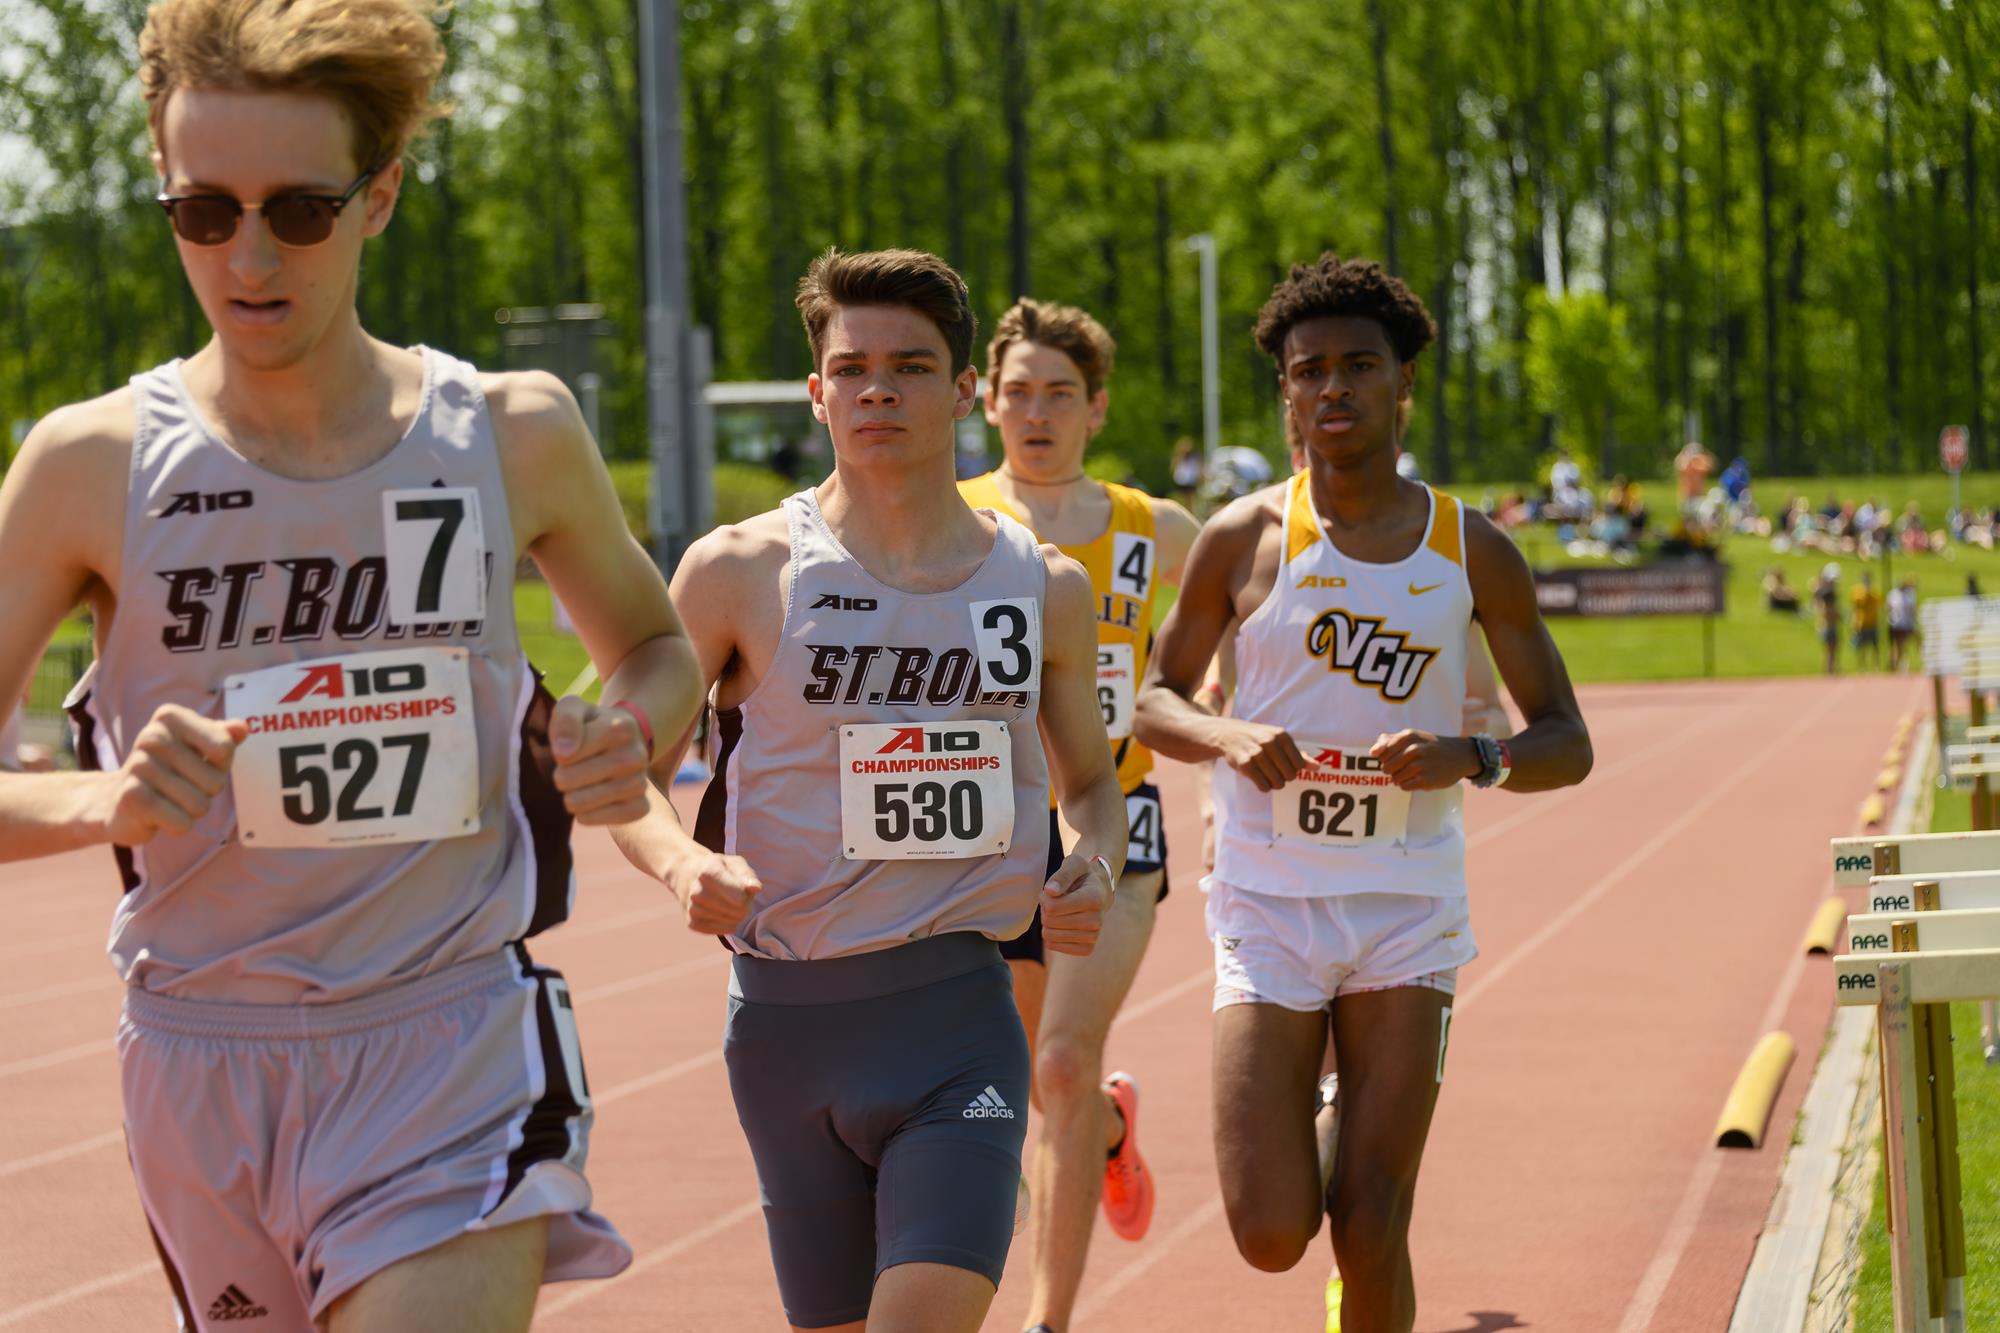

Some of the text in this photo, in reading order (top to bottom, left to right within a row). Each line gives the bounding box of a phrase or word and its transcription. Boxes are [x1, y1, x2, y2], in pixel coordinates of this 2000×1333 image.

[158, 489, 253, 518] A10
[396, 498, 465, 613] 7
[1119, 541, 1146, 594] 4
[155, 551, 494, 653] ST.BO
[809, 593, 878, 611] A10
[982, 604, 1032, 686] 3
[1306, 608, 1441, 704] VCU
[278, 663, 426, 704] A10
[803, 645, 1031, 708] ST.BO
[243, 696, 457, 734] CHAMPIONSHIPS
[851, 756, 1000, 774] CHAMPIONSHIPS
[876, 727, 980, 754] A10
[279, 732, 431, 825] 527
[874, 780, 984, 842] 530
[1129, 804, 1152, 858] 4
[1298, 789, 1378, 837] 621
[962, 1106, 1014, 1119] adidas
[207, 1305, 269, 1321] adidas
